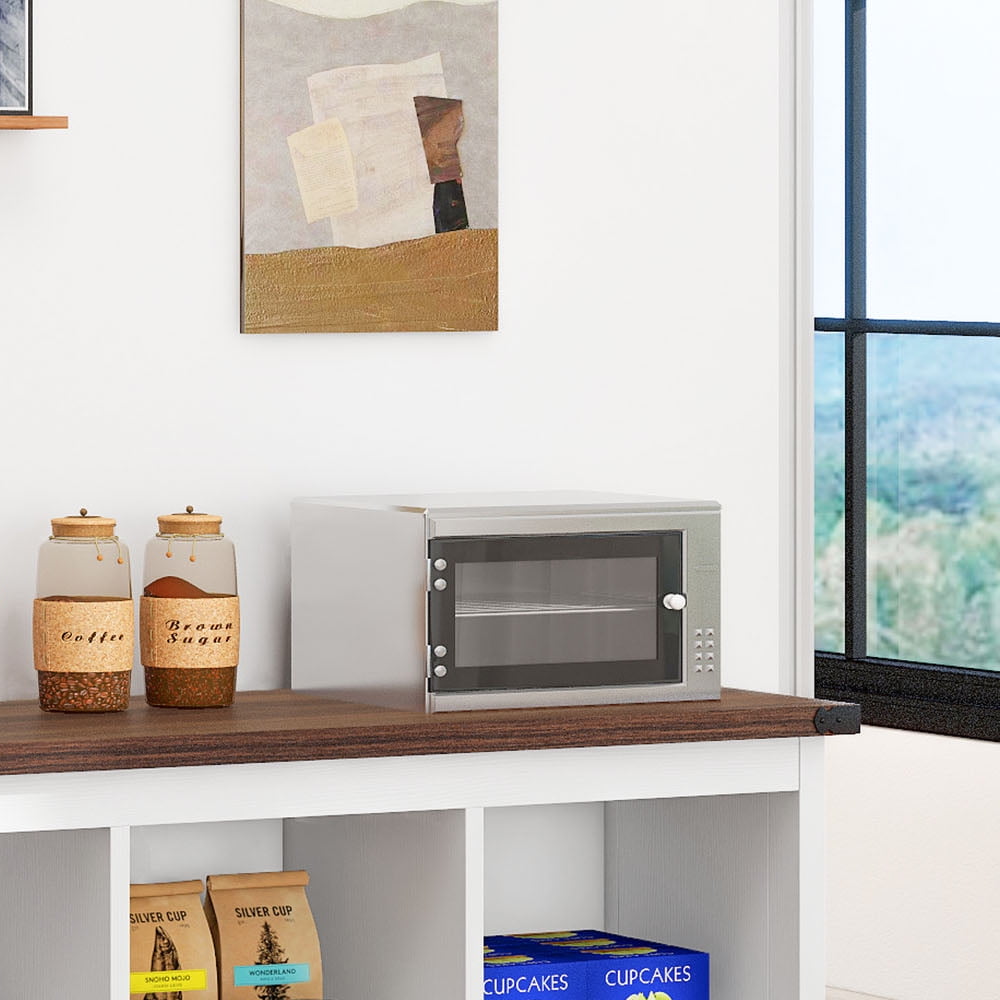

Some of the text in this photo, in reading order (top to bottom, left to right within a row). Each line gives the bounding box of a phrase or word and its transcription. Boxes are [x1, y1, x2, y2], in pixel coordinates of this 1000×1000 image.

[165, 619, 233, 632] Brown
[61, 631, 124, 644] Coffee
[166, 632, 232, 646] Sugar
[129, 910, 187, 924] SILVER CUP
[234, 905, 293, 919] SILVER CUP
[249, 968, 297, 976] WONDERLAND
[605, 965, 692, 987] CUPCAKES
[483, 974, 569, 996] CUPCAKES
